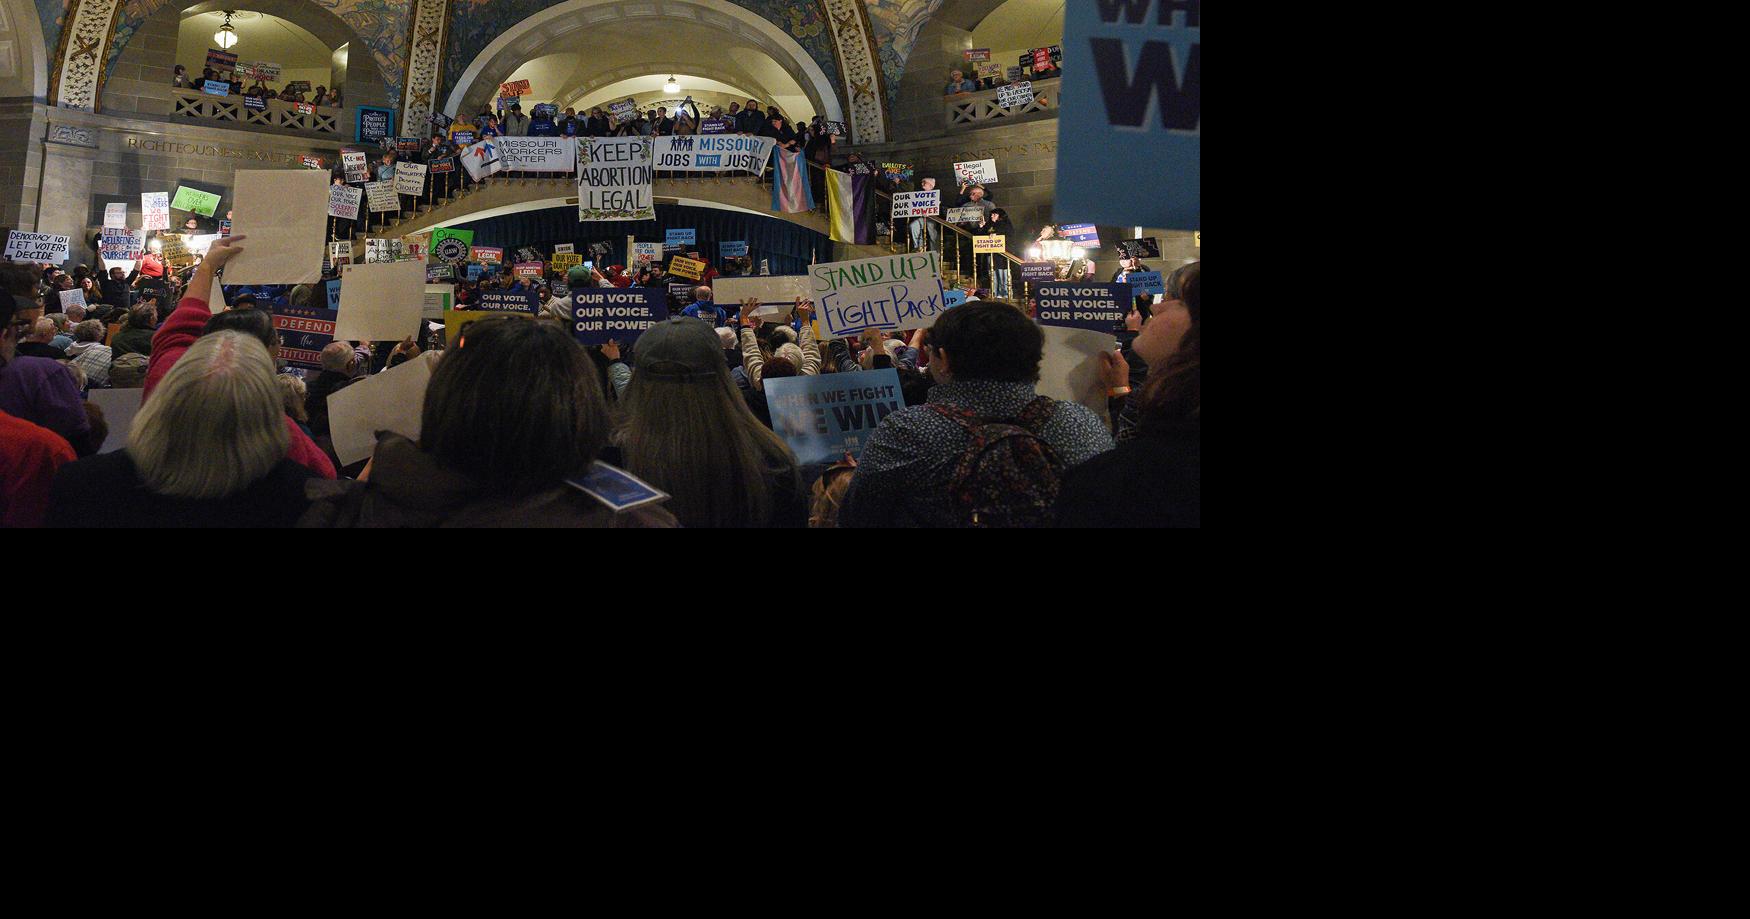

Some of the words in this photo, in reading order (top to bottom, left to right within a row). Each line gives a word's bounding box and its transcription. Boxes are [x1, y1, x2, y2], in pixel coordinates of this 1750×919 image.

[499, 140, 558, 149] MISSOURI
[700, 138, 765, 155] MISSOURI
[500, 148, 562, 157] WORKERS
[590, 143, 643, 163] KEEP
[501, 156, 546, 164] CENTER
[657, 153, 691, 167] JOBS
[699, 156, 718, 165] WITH
[579, 166, 652, 188] ABORTION
[590, 190, 648, 210] LEGAL
[912, 200, 936, 208] VOICE
[911, 207, 938, 216] POWER
[10, 231, 51, 242] DEMOCRACY
[104, 229, 119, 237] LET
[121, 228, 134, 237] THE
[9, 240, 32, 249] LET
[35, 242, 68, 252] VOTERS
[15, 250, 54, 260] DECIDE
[890, 253, 937, 280] UP!
[1040, 288, 1070, 297] OUR
[1072, 289, 1113, 297] VOTE.
[481, 294, 502, 302] OUR
[576, 295, 603, 304] OUR
[606, 295, 648, 304] VOTE.
[481, 302, 501, 310] OUR
[1040, 300, 1070, 308] OUR
[1073, 301, 1119, 309] VOICE.
[576, 307, 603, 317] OUR
[606, 307, 653, 317] VOICE.
[1041, 311, 1071, 320] OUR
[280, 319, 332, 332] DEFEND
[576, 321, 603, 331] OUR
[824, 390, 846, 403] WE
[850, 385, 895, 402] FIGHT
[832, 401, 900, 432] WIN
